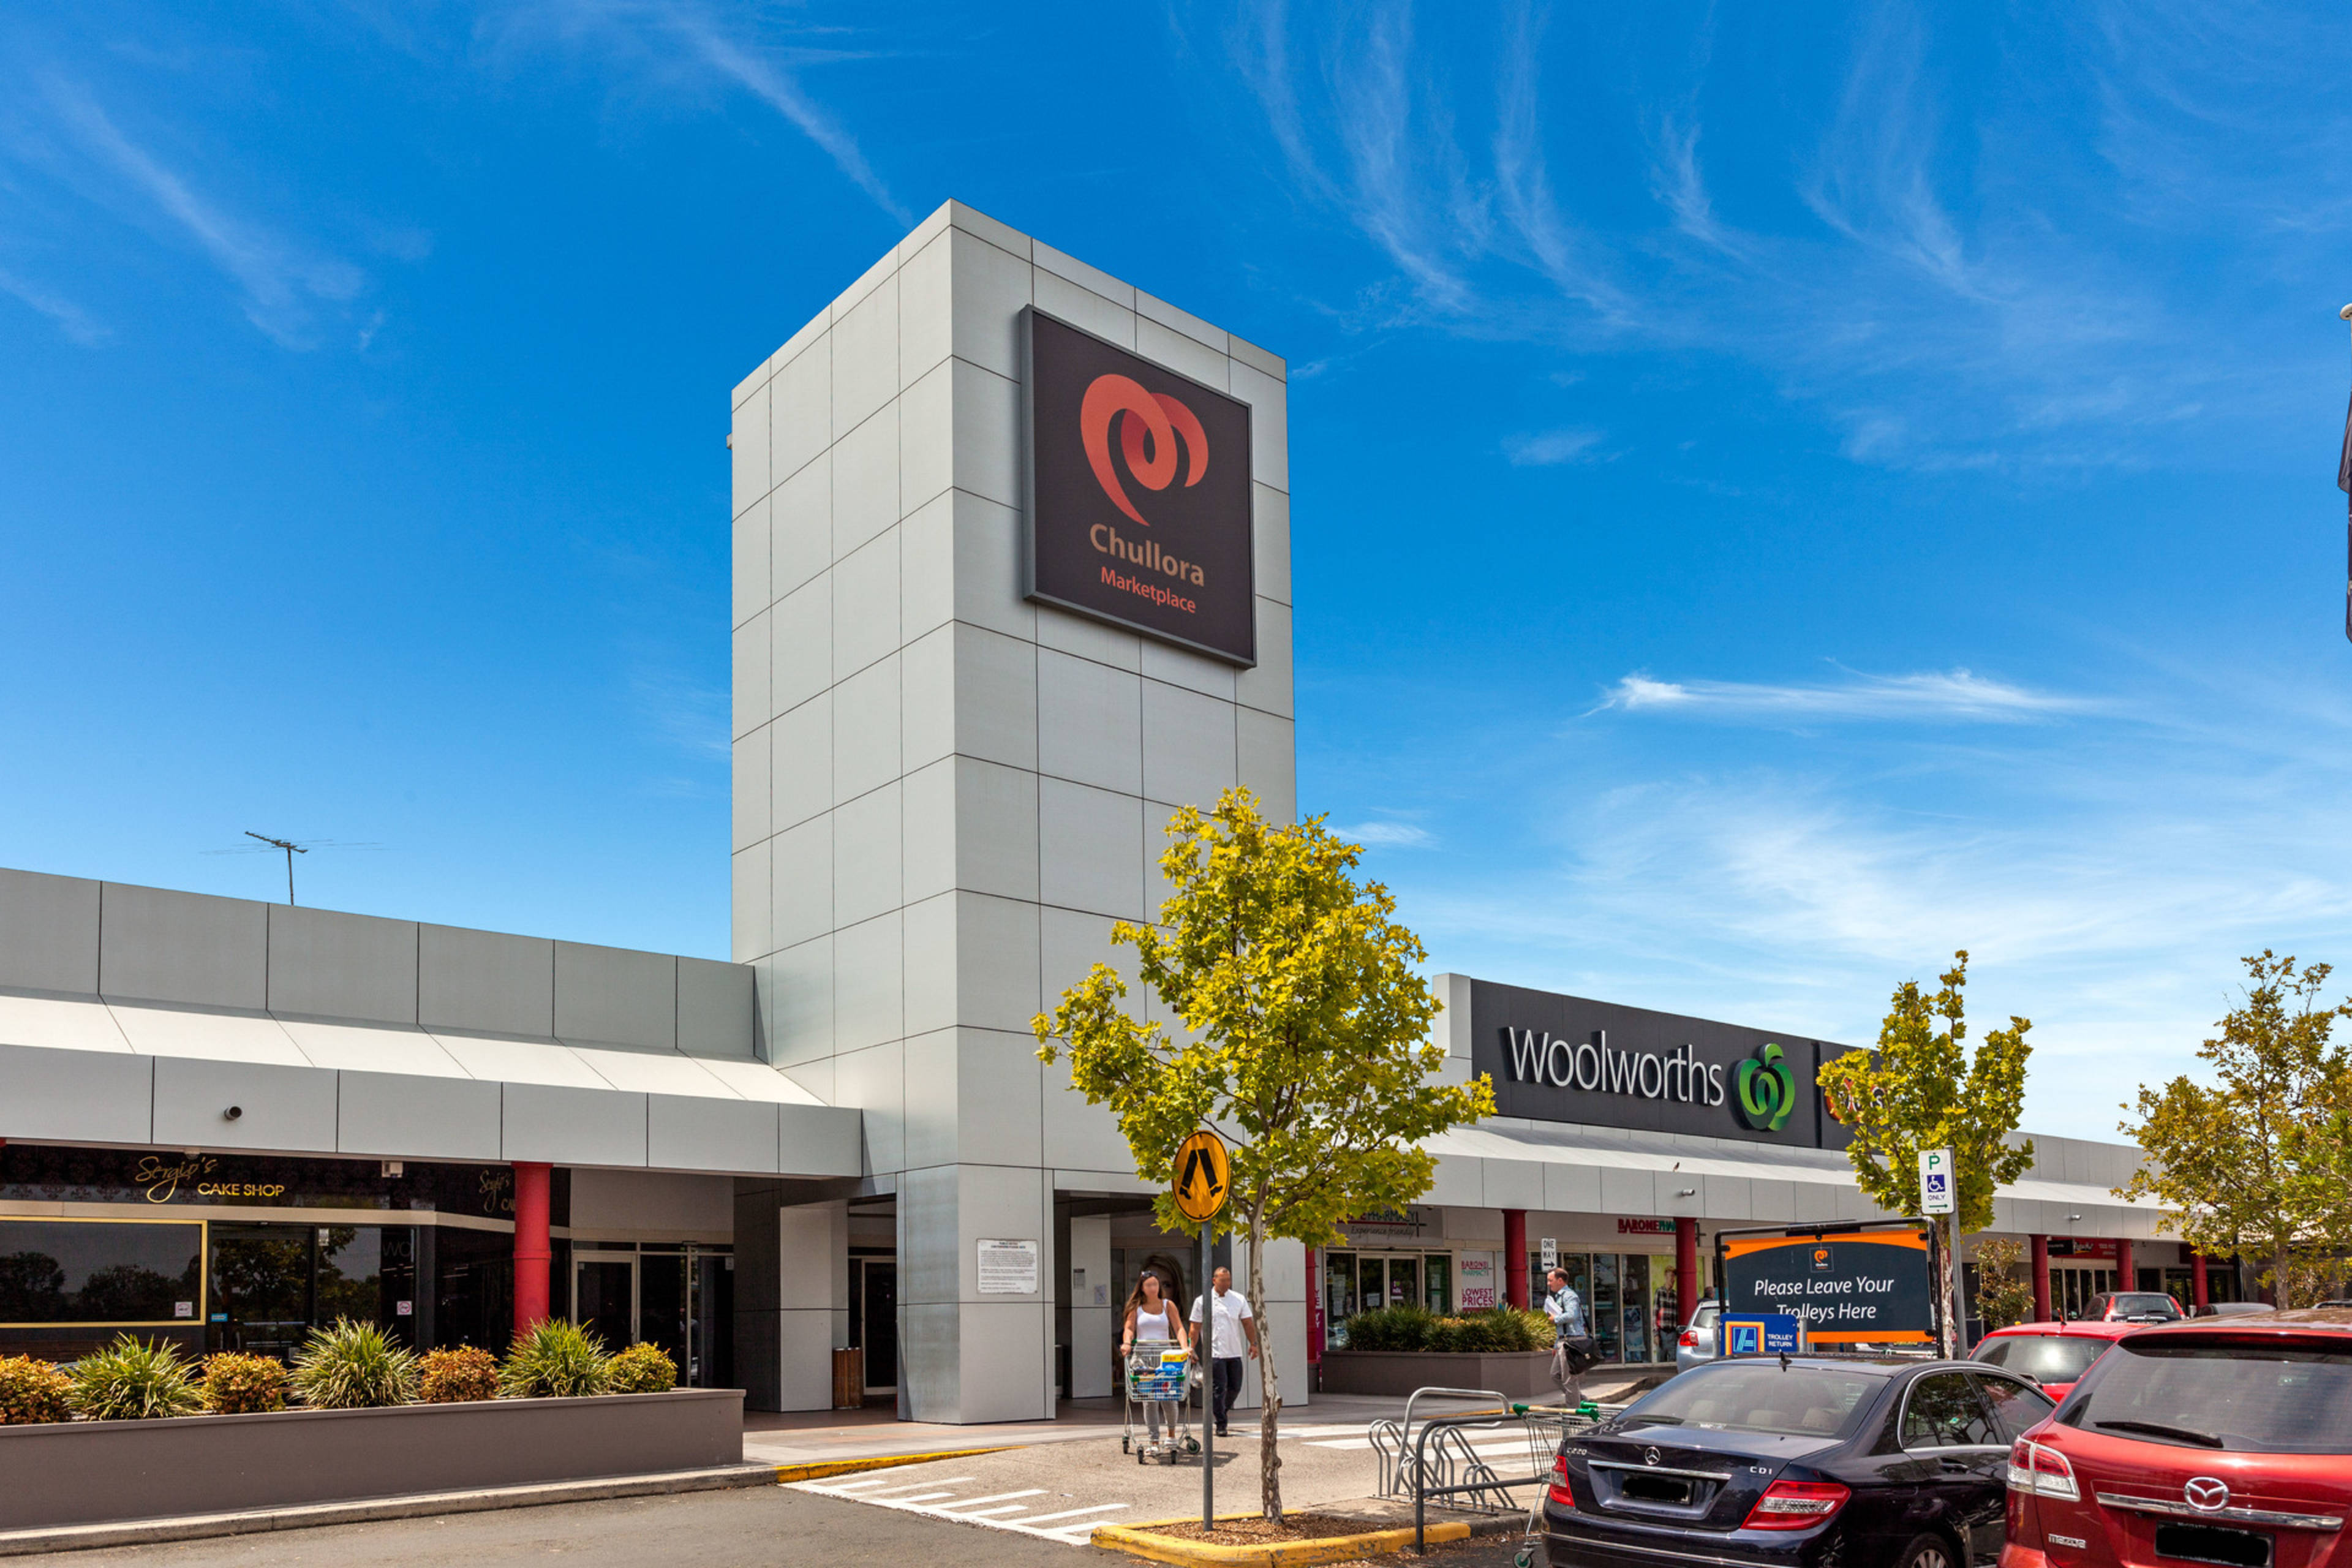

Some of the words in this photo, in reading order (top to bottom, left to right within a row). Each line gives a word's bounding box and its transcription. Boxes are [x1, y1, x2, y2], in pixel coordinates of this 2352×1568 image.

[1090, 523, 1204, 587] Chullora
[1101, 566, 1196, 614] Marketplace
[1509, 1027, 1724, 1106] Woolworths
[1929, 1155, 1940, 1170] P
[135, 1156, 218, 1203] Sergio's
[197, 1183, 240, 1195] CAKE
[243, 1184, 285, 1196] SHOP
[1544, 1240, 1555, 1249] ONE
[1754, 1279, 1803, 1296] Please
[1806, 1278, 1852, 1294] Leave
[1856, 1276, 1894, 1292] Your
[1462, 1296, 1493, 1306] PRICES
[1839, 1303, 1877, 1319] Here
[1566, 1447, 1588, 1456] C220
[1750, 1466, 1773, 1475] CDI
